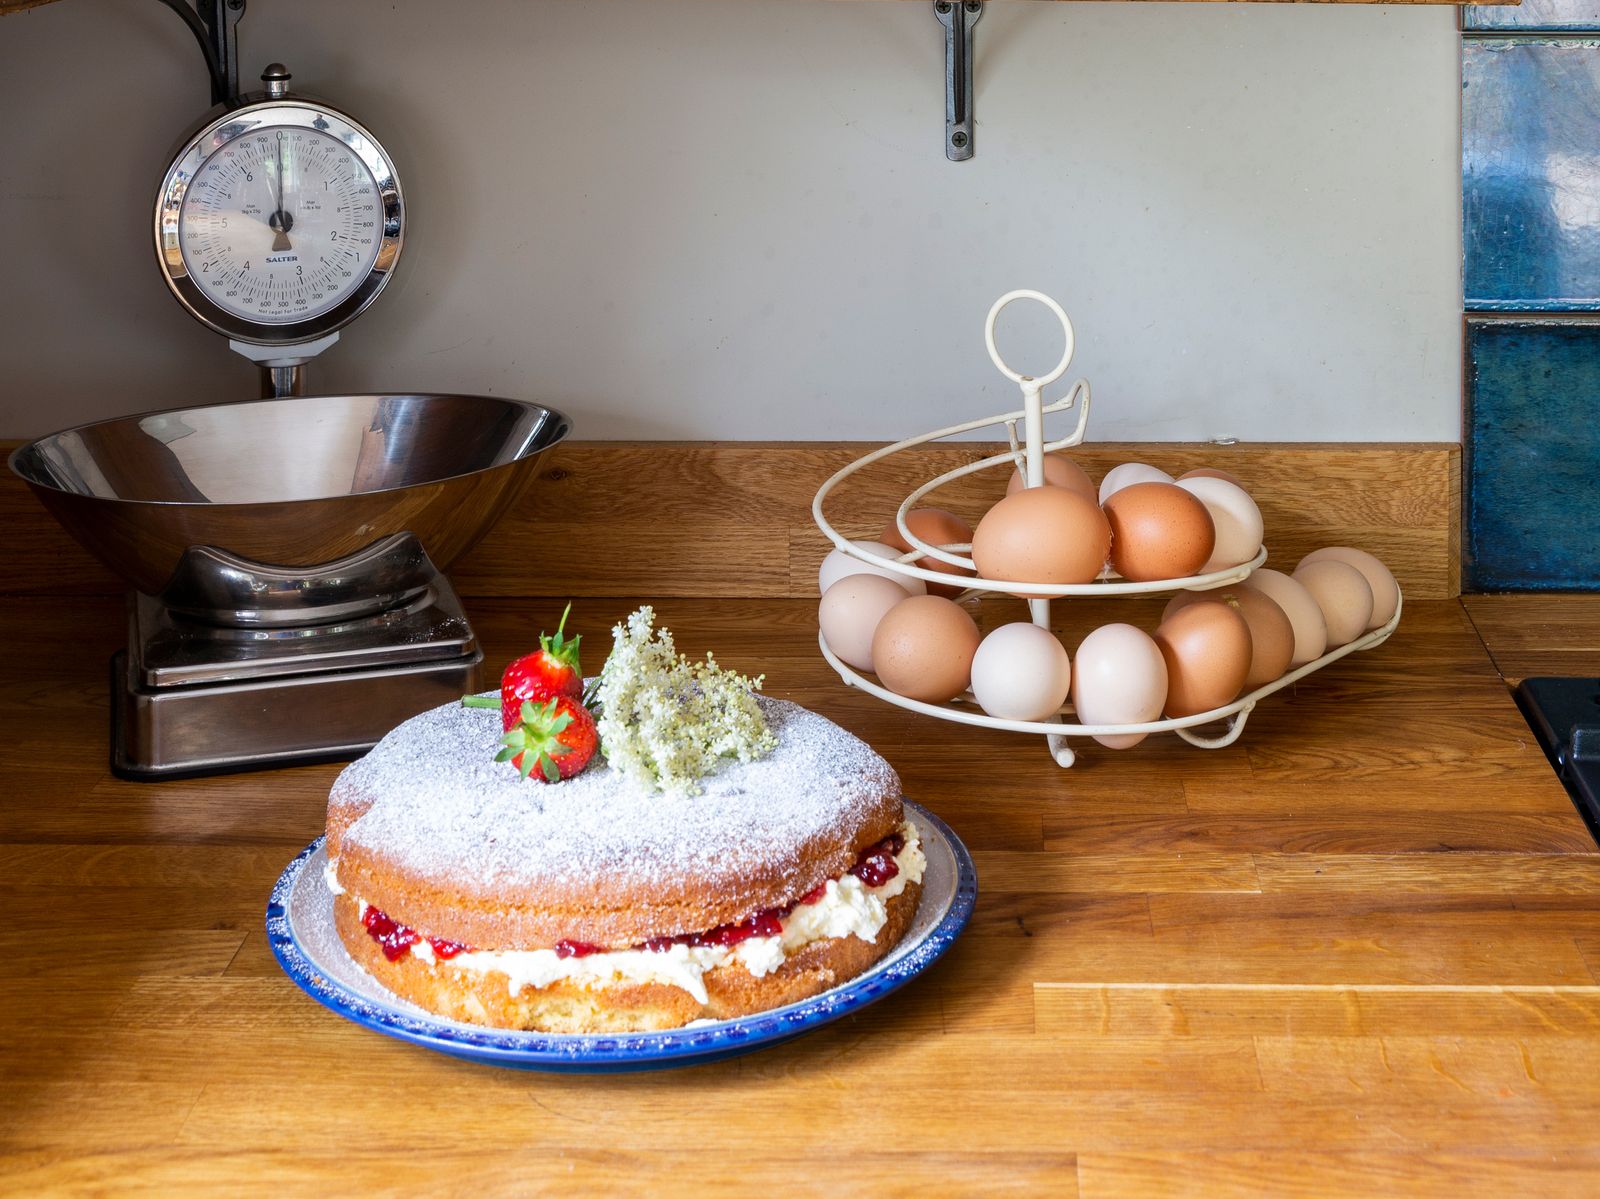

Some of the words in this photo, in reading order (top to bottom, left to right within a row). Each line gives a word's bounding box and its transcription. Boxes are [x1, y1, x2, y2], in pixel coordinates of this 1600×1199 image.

[276, 131, 283, 141] 0
[246, 172, 253, 182] 6
[324, 181, 328, 191] 1
[222, 218, 228, 228] 5
[331, 231, 337, 241] 2
[266, 255, 298, 263] SALTER
[355, 253, 360, 262] 1
[202, 263, 209, 272] 2
[243, 261, 250, 271] 4
[296, 266, 302, 275] 3
